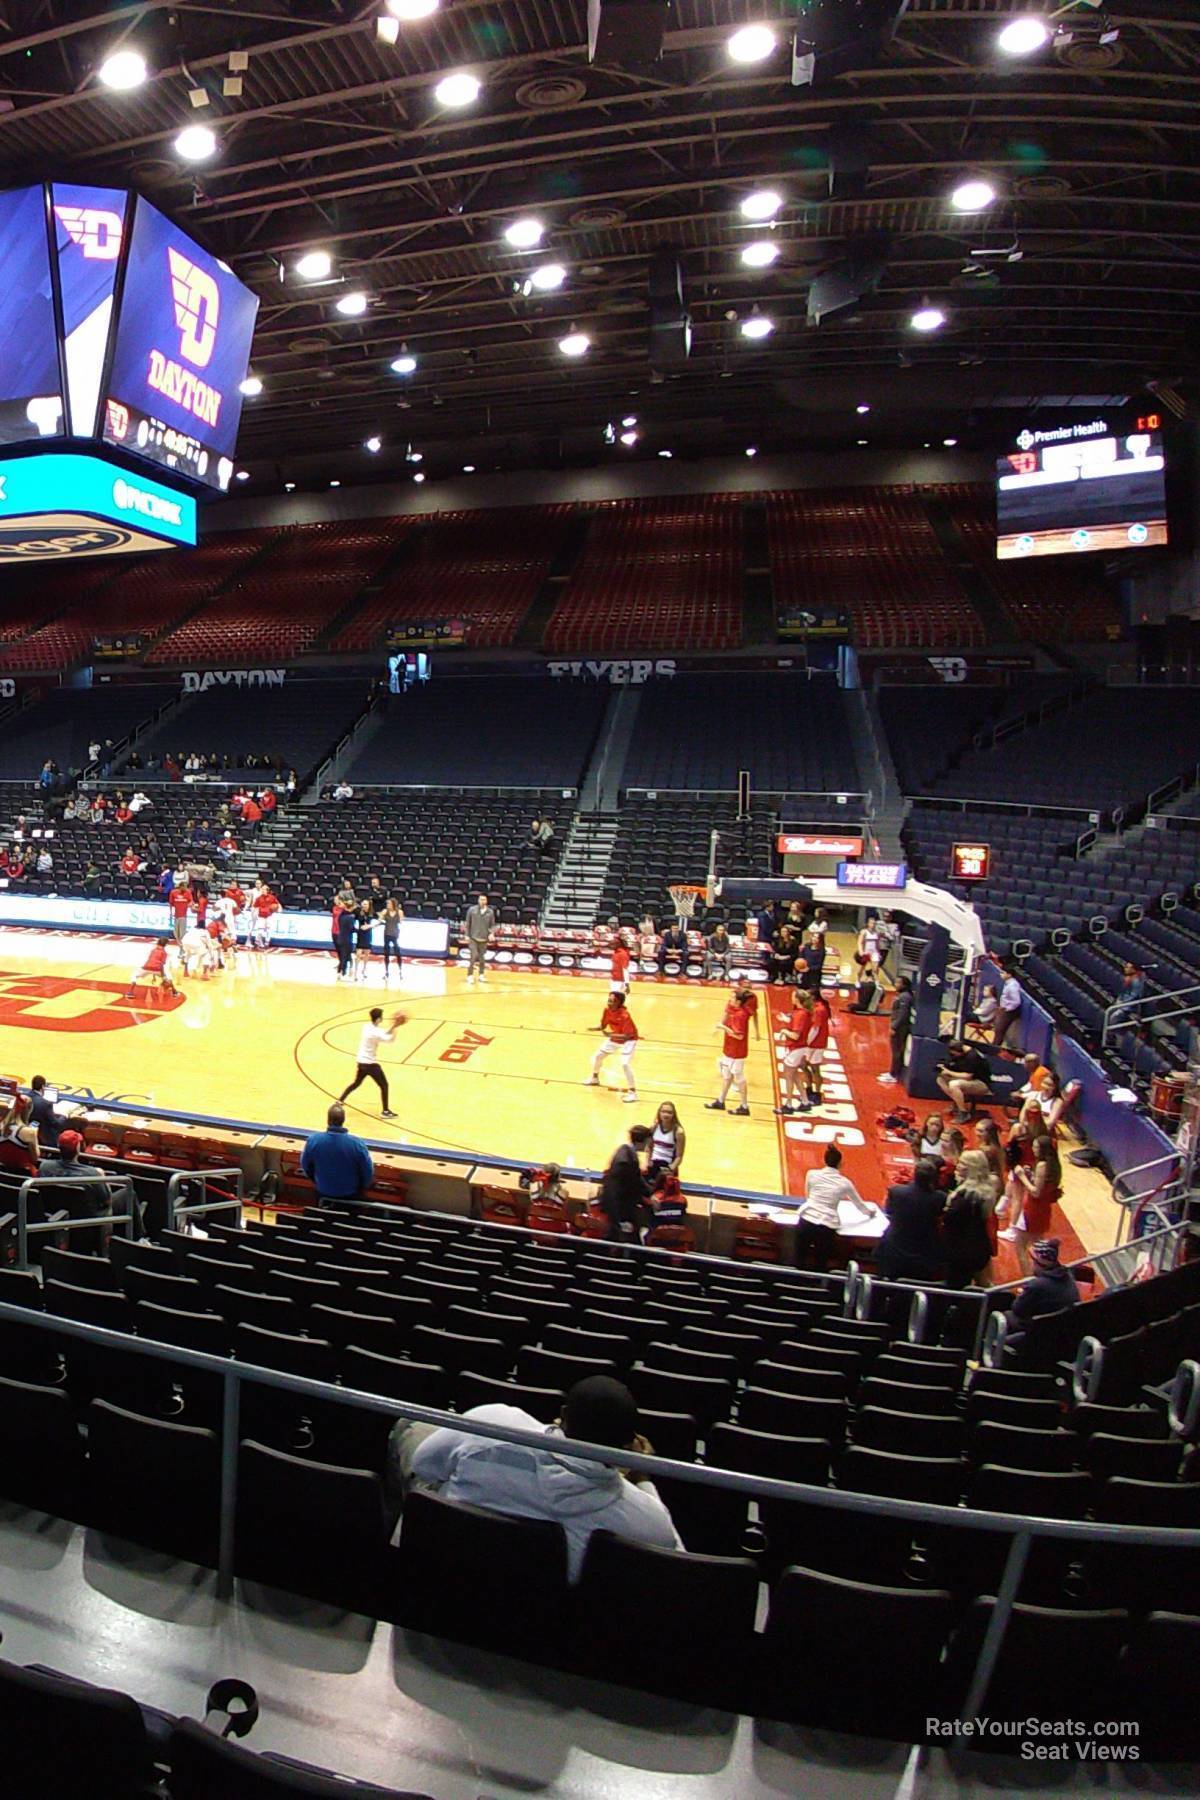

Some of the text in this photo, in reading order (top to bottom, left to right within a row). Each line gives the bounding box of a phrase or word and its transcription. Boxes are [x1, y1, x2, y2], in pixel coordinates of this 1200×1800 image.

[147, 348, 222, 428] DAYTON
[1034, 421, 1108, 443] Premier Health
